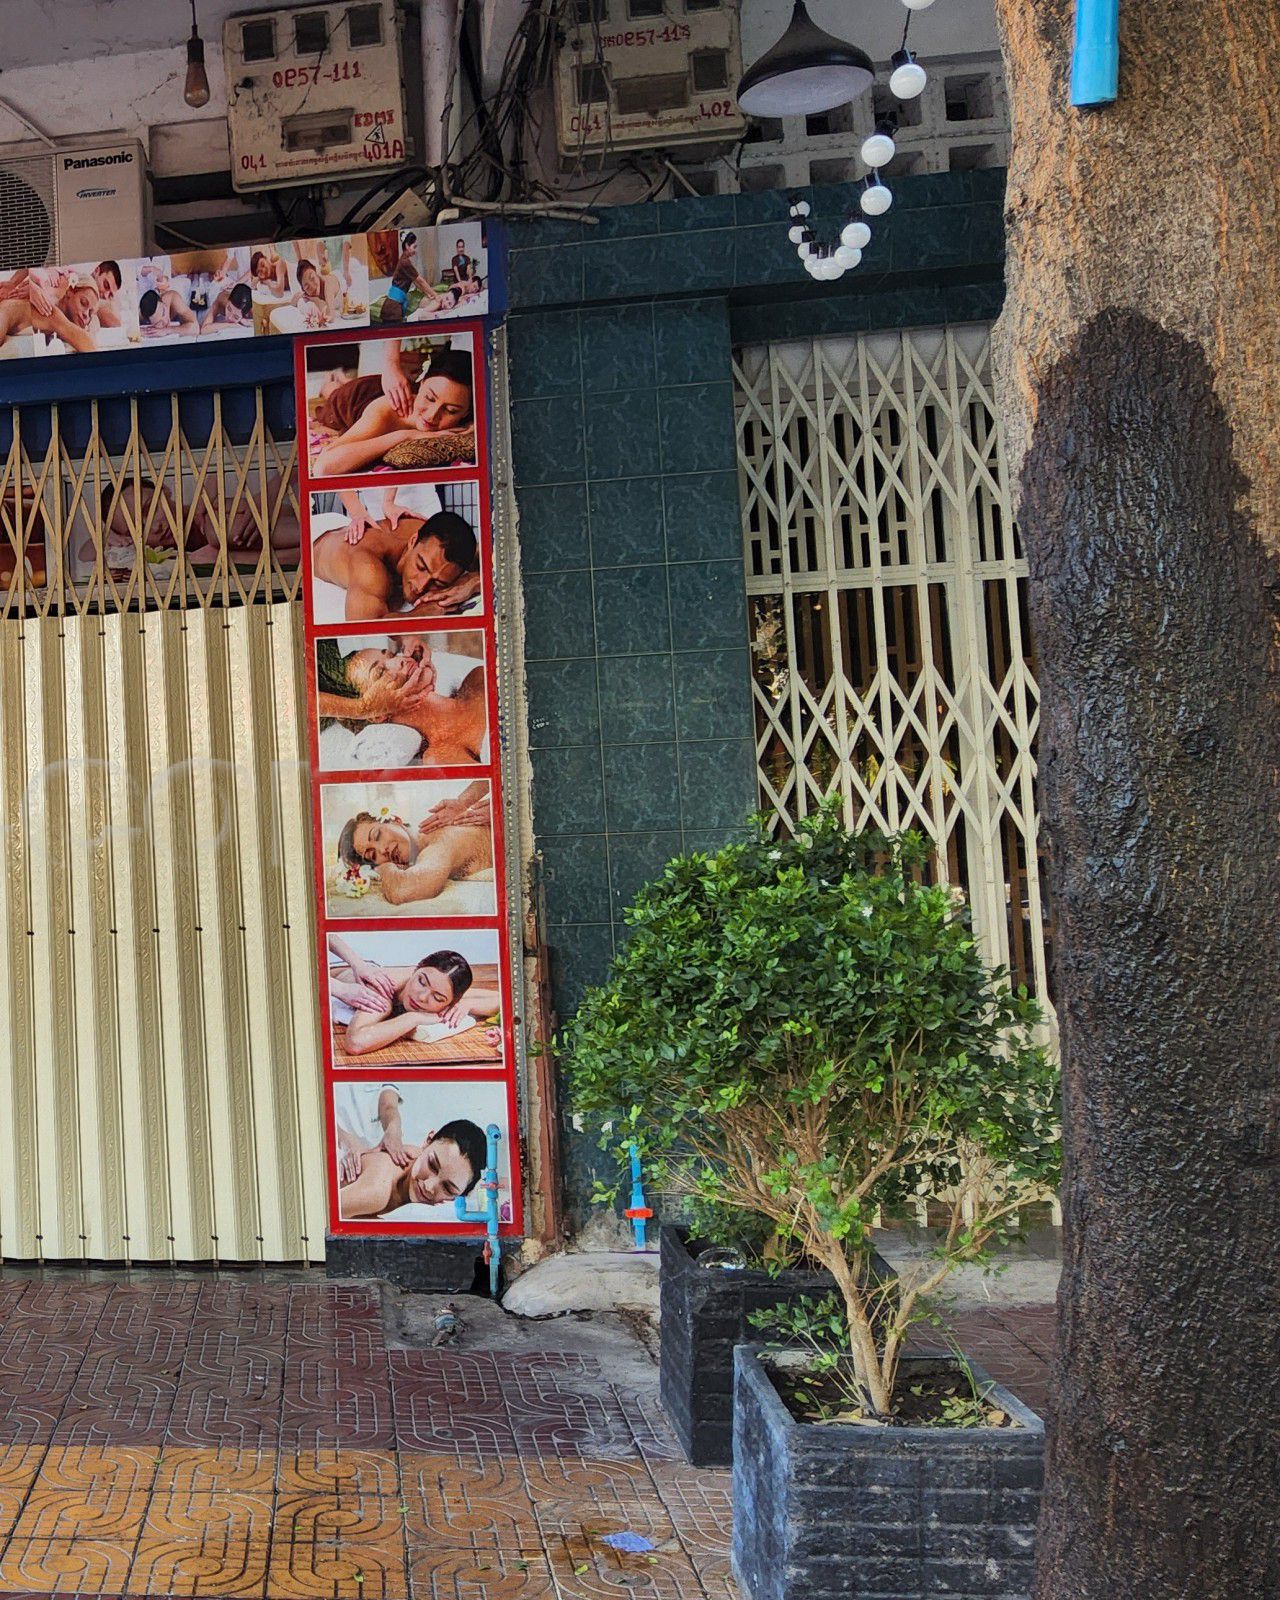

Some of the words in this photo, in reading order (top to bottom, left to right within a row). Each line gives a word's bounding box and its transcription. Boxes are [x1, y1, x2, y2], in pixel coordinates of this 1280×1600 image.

[363, 139, 405, 162] 401A
[63, 151, 133, 171] Panasonic
[241, 154, 268, 174] 041
